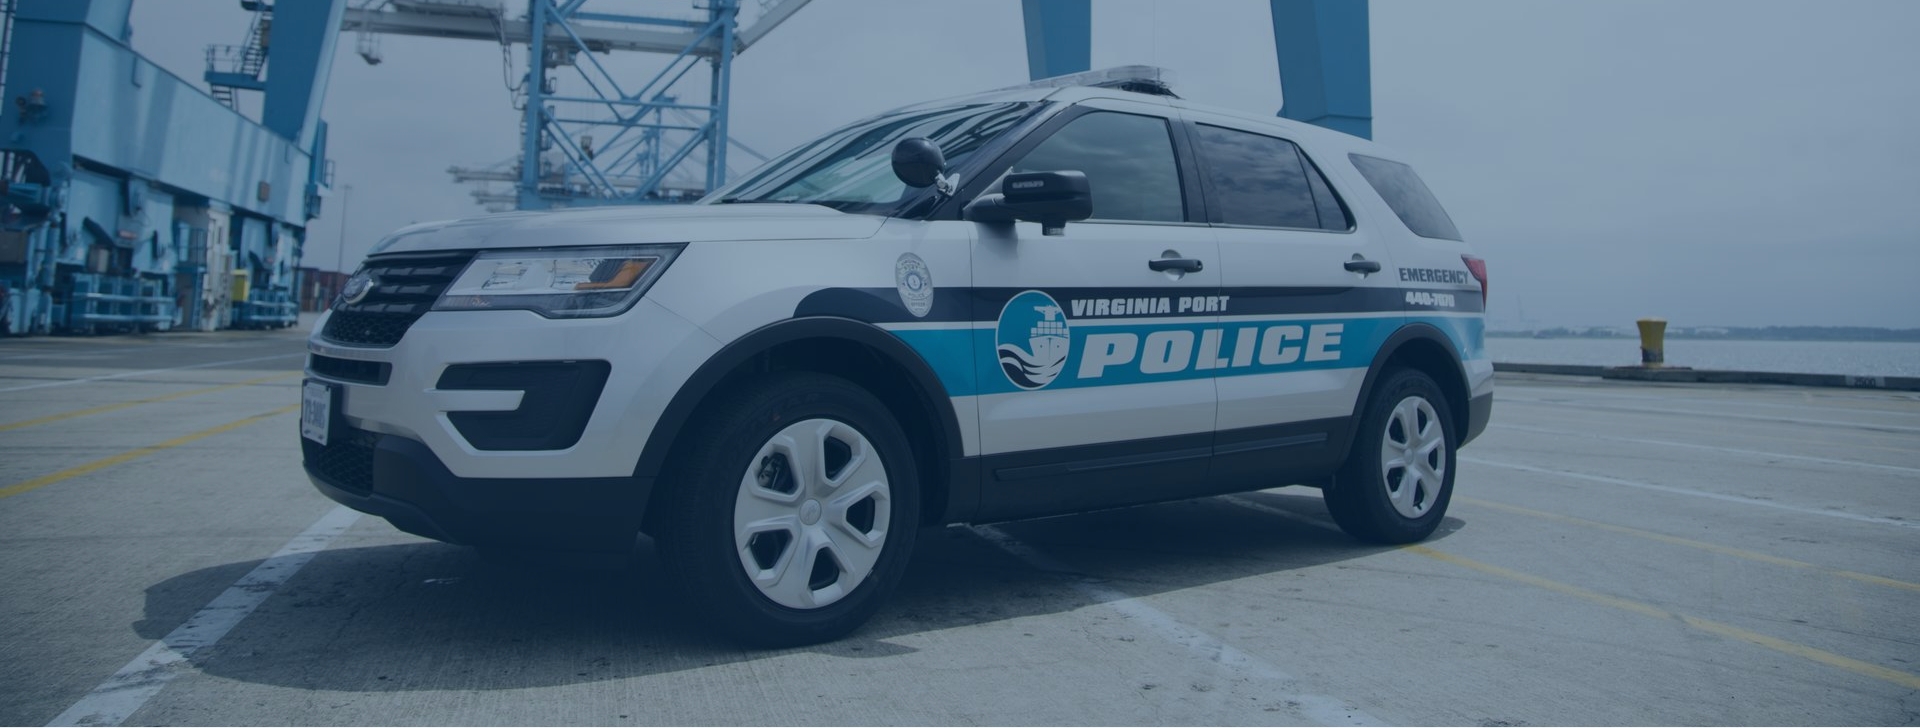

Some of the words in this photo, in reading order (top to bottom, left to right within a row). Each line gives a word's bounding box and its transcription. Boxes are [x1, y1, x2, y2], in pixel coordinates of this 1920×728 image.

[1399, 267, 1469, 285] EMERGENCY
[1071, 297, 1171, 317] VIRGINIA
[1178, 295, 1230, 313] PORT
[1077, 323, 1345, 379] POLICE
